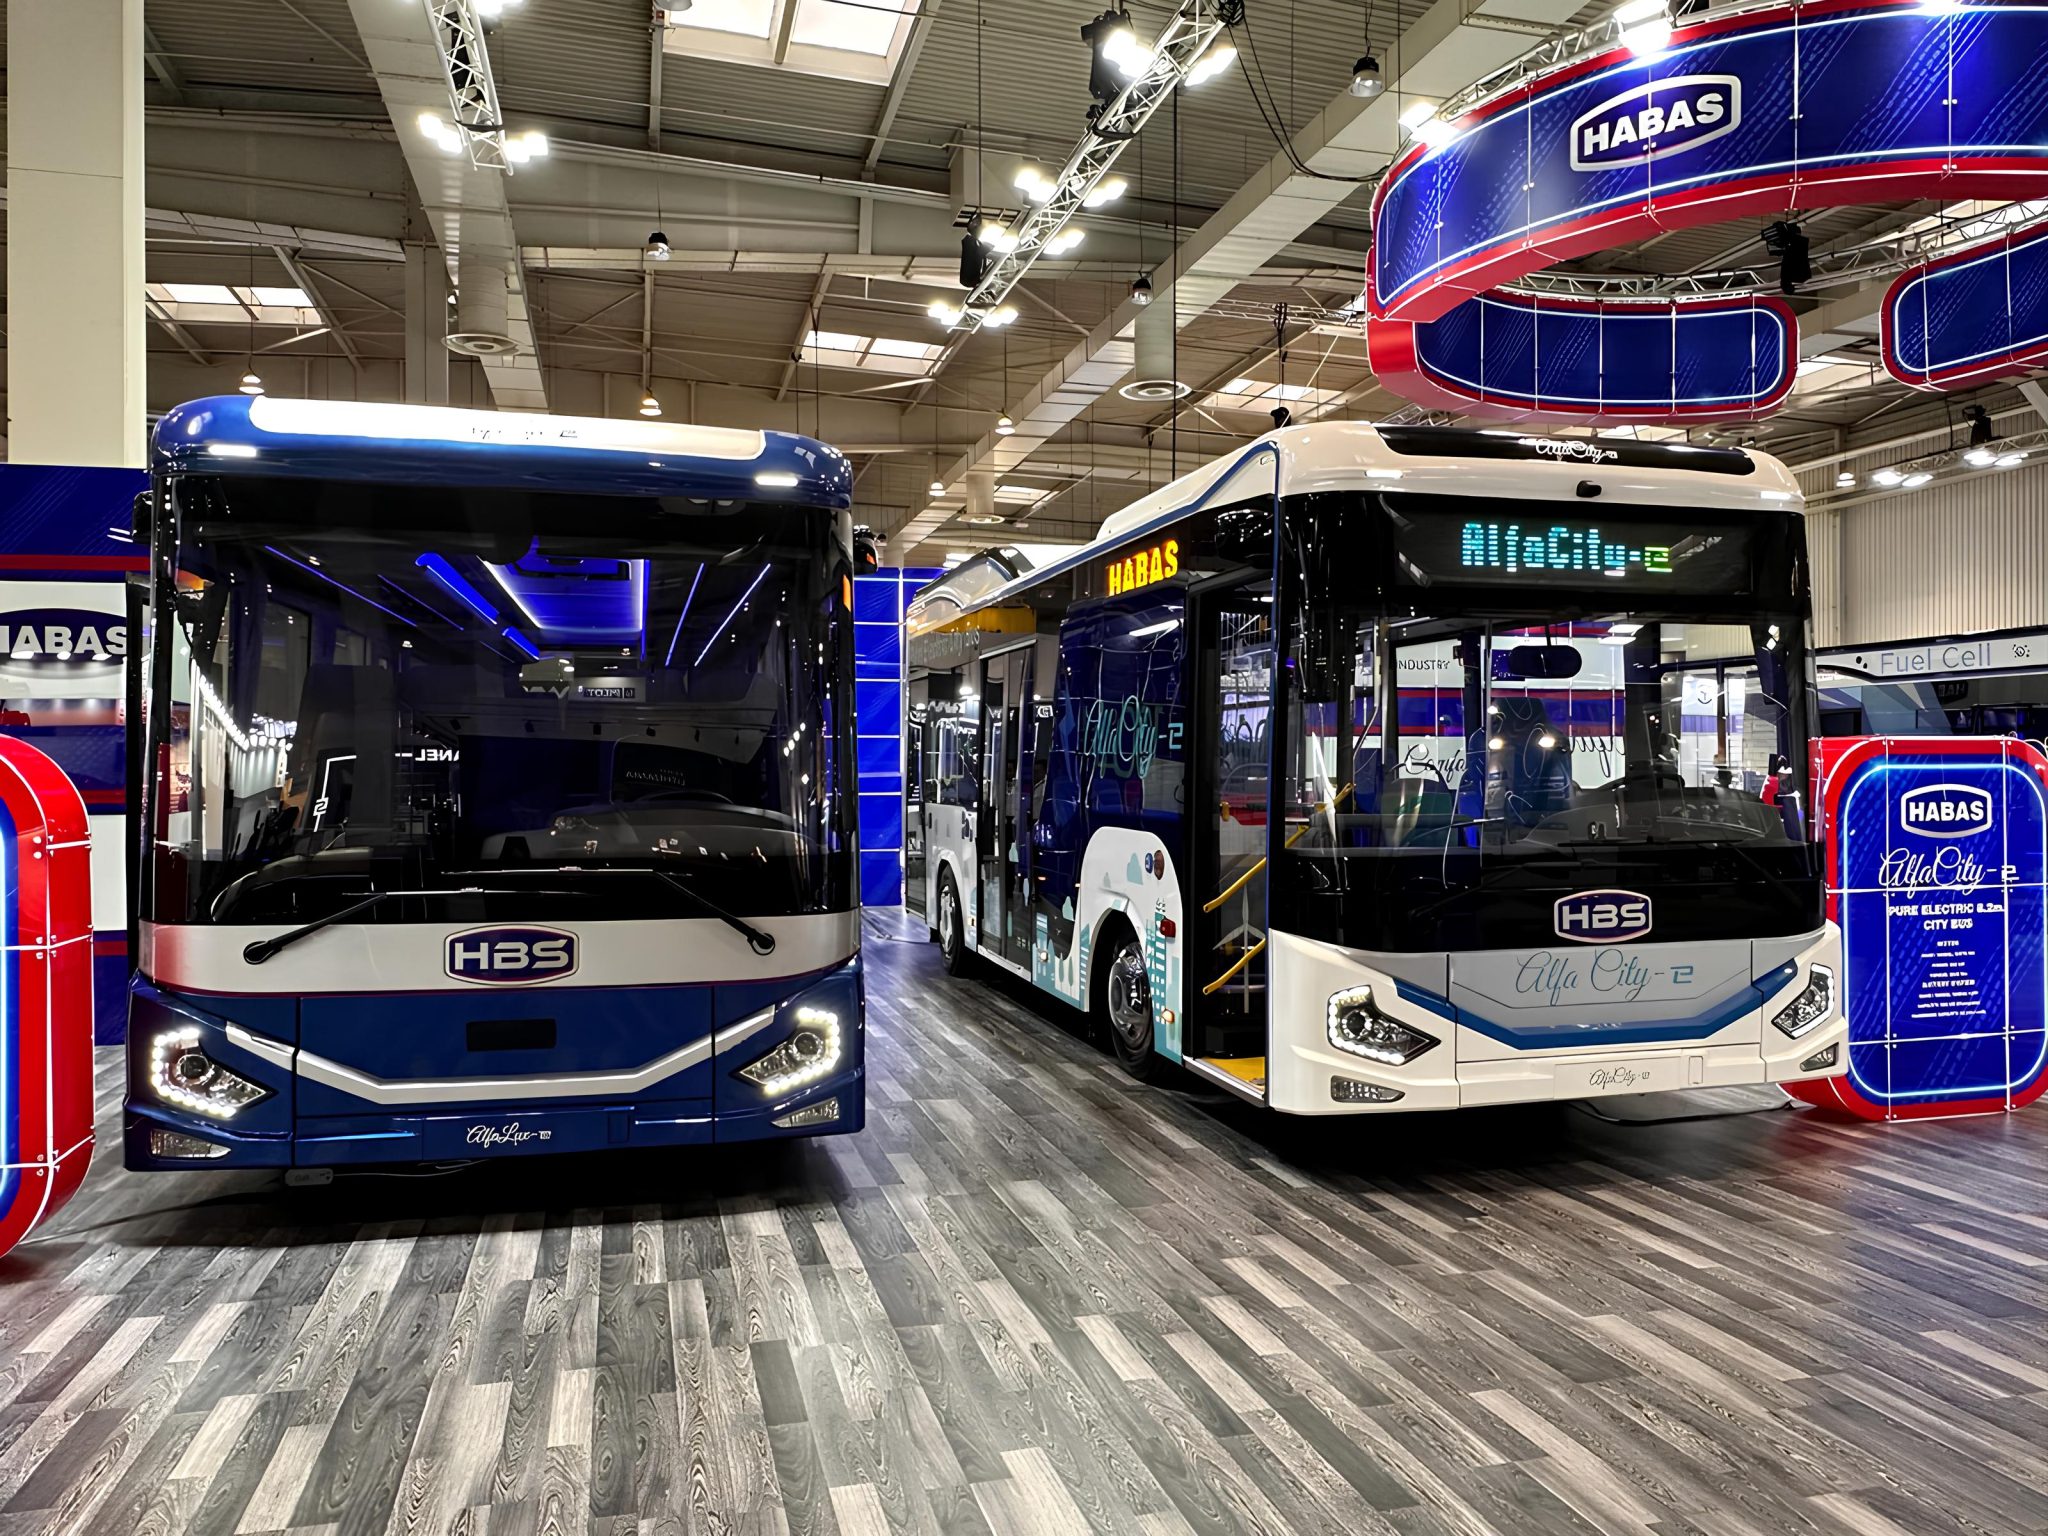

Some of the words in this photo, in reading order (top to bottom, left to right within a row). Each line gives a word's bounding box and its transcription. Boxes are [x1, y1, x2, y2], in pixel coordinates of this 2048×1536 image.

[1583, 92, 1725, 157] HABAS
[1108, 540, 1179, 597] HABAS
[1398, 659, 1451, 670] NDUSTRY
[1881, 648, 1931, 675] Fuel
[1942, 642, 1991, 669] Cell
[1908, 800, 1985, 822] HABAS
[1562, 902, 1647, 930] HBS
[1888, 905, 1919, 917] PURE
[1921, 903, 1974, 916] ELECTRIC
[1923, 918, 1949, 931] CITY
[1950, 918, 1974, 930] BUS
[454, 938, 569, 971] HBS
